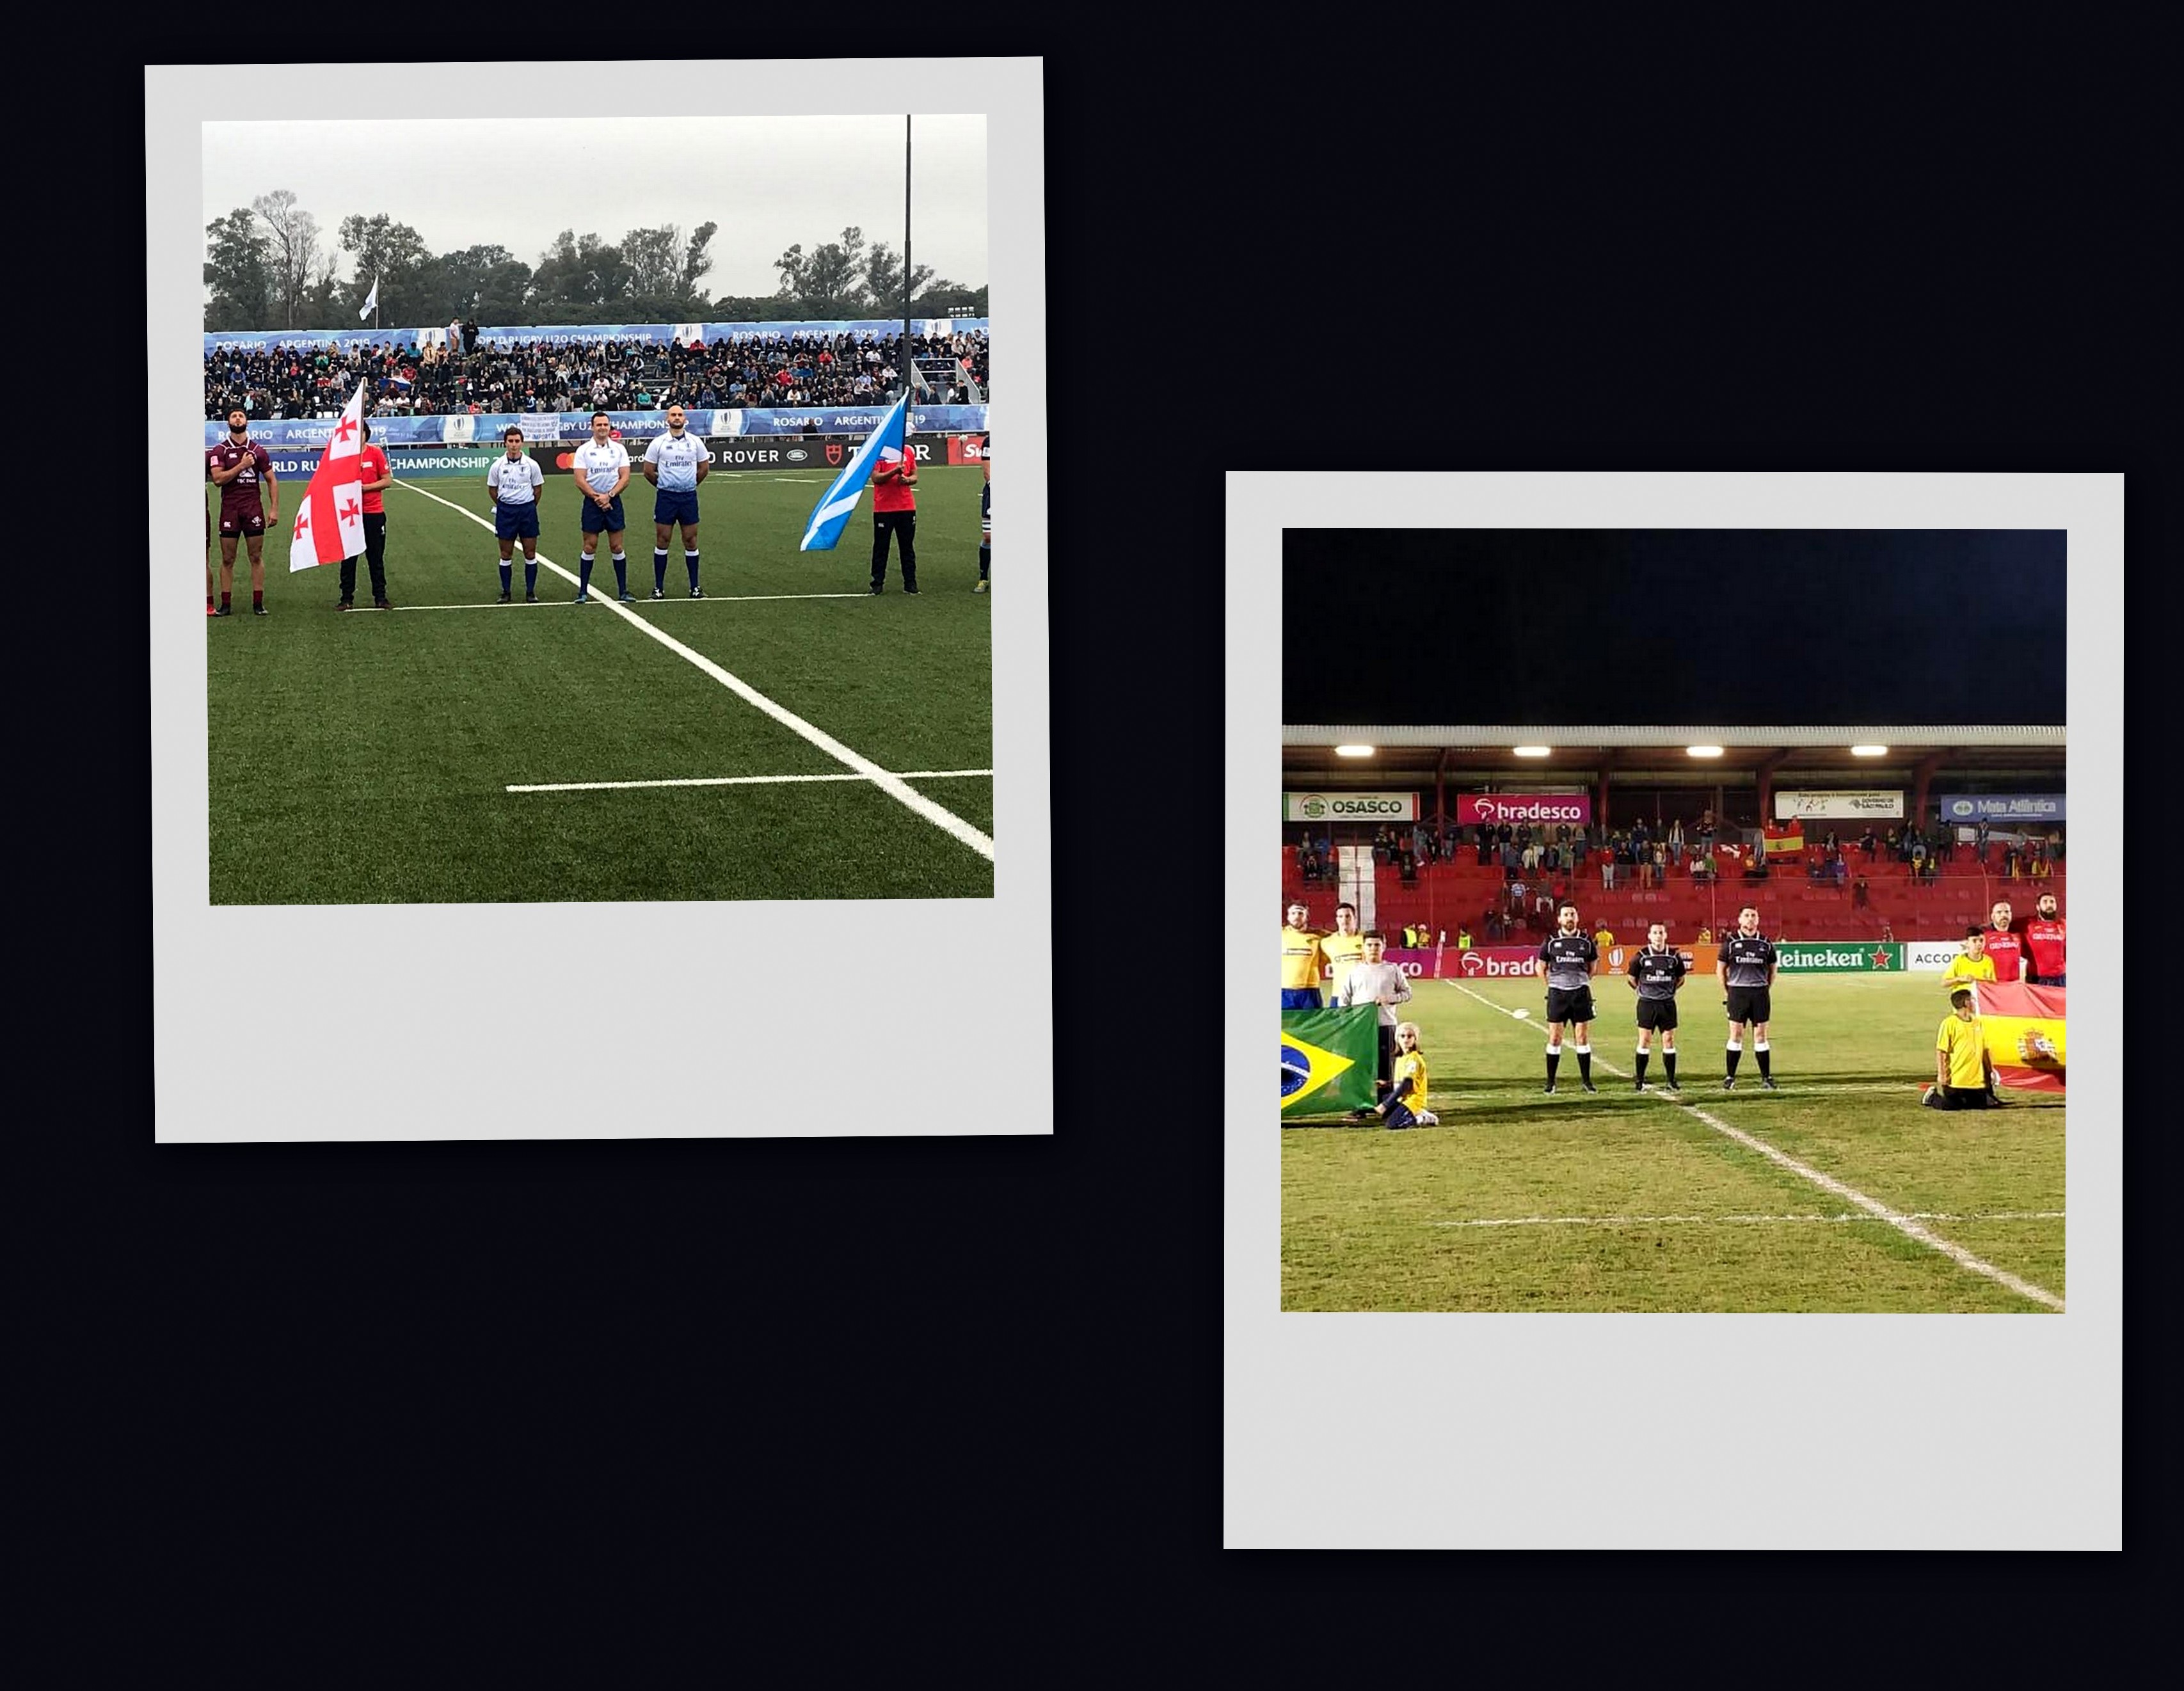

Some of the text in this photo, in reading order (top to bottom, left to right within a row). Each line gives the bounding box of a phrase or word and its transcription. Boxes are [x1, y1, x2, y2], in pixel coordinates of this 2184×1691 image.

[854, 328, 879, 338] 2019
[344, 337, 371, 348] 2019
[508, 335, 543, 344] RUGBY
[773, 416, 824, 427] ROSARO
[834, 415, 884, 425] ARGENTI
[723, 450, 779, 463] ROVER
[391, 456, 490, 470] CHAMPIONSHIP
[1332, 801, 1402, 813] OSASCO
[1497, 802, 1581, 819] bradesco
